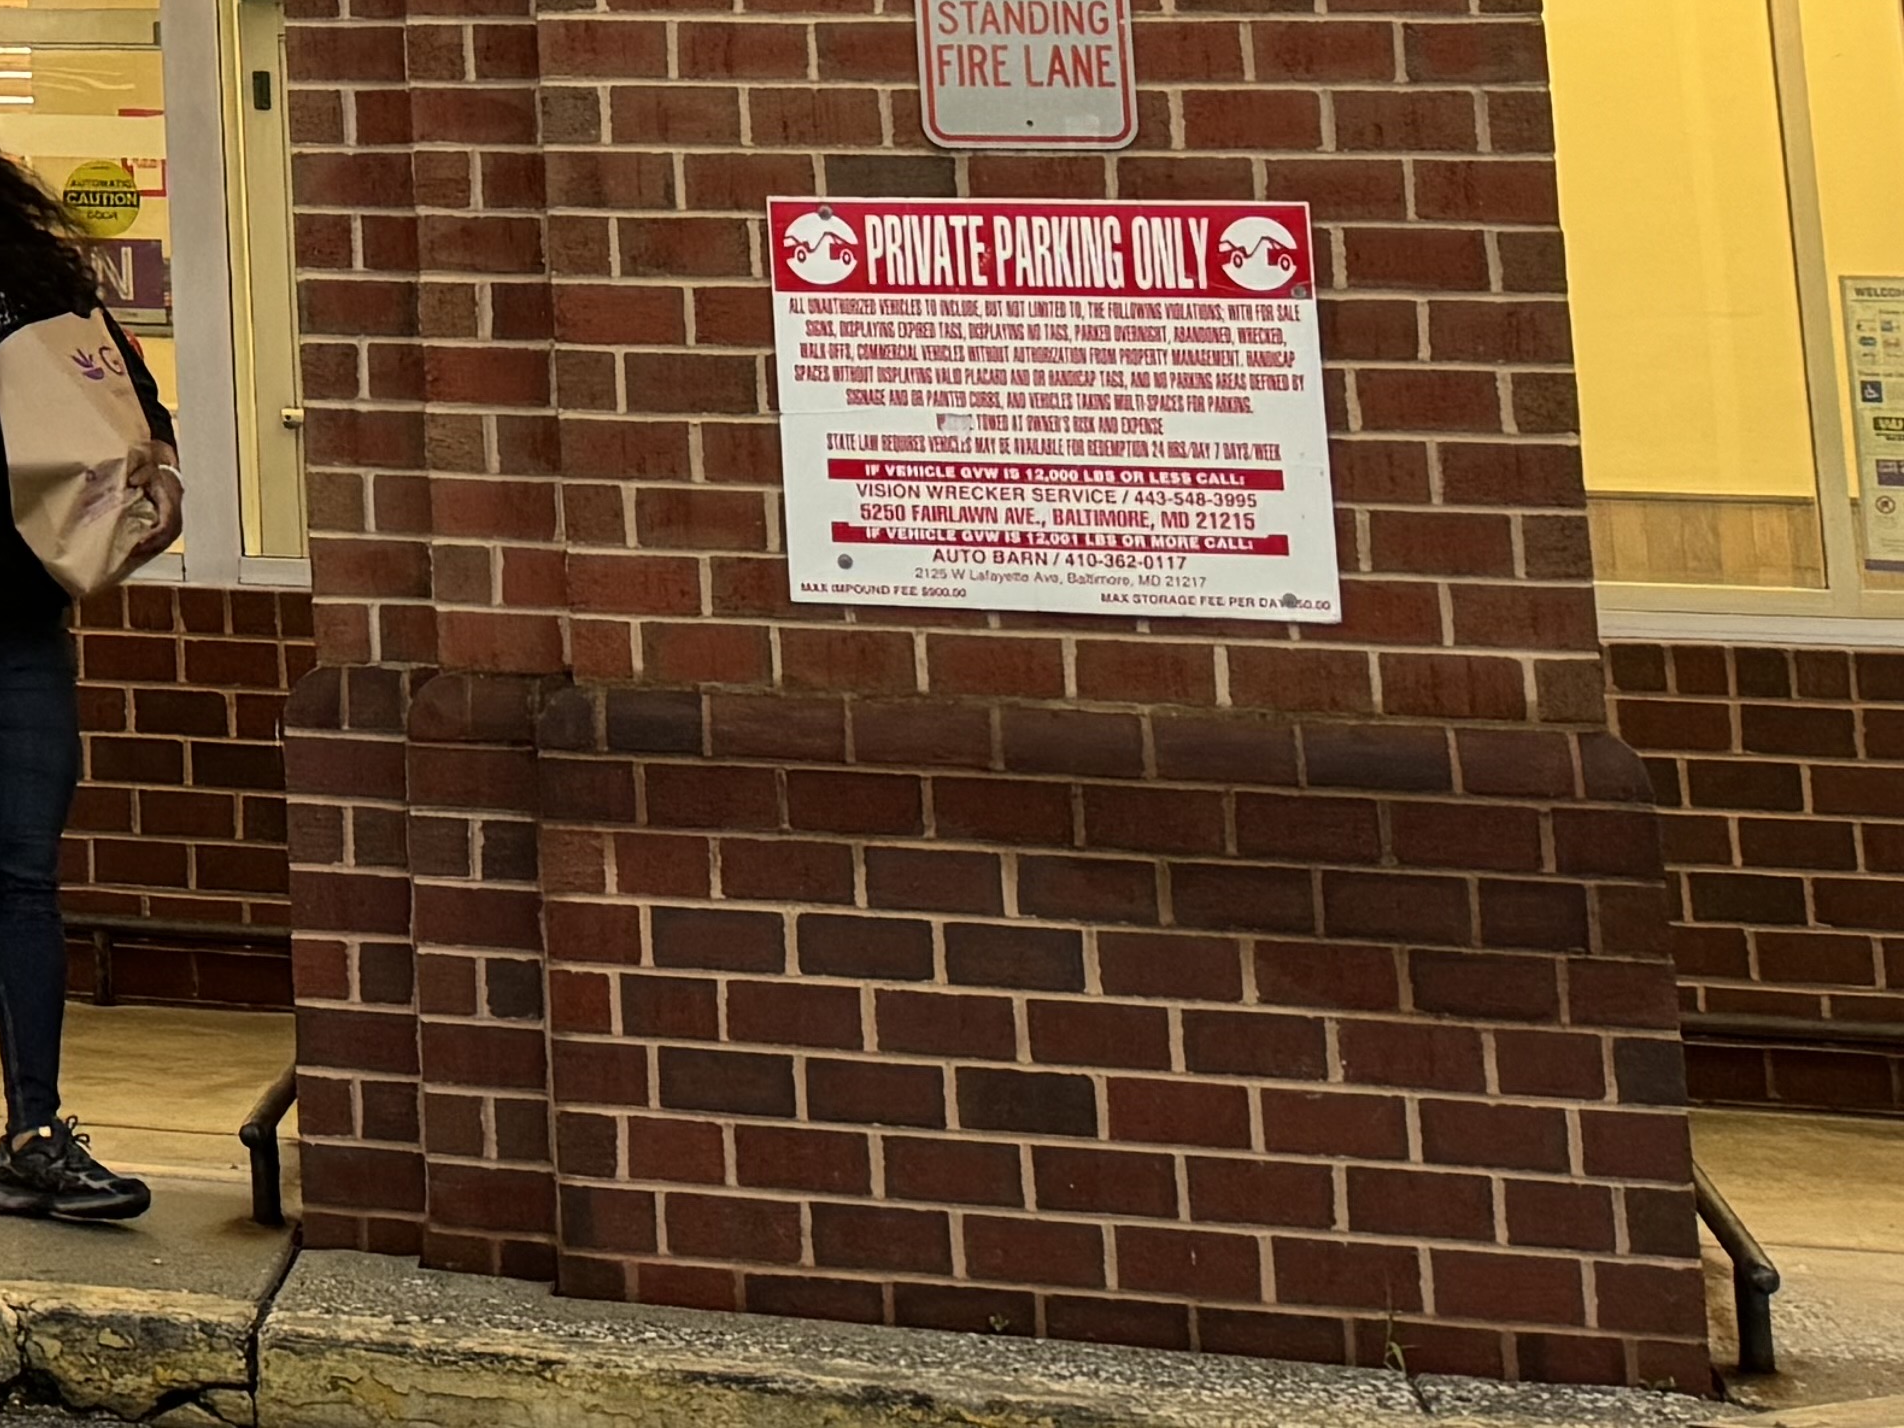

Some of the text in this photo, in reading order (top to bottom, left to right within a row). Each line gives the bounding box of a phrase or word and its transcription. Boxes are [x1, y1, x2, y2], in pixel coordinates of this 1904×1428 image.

[938, 0, 1109, 36] STANDING
[937, 44, 1116, 88] FIRE LANE
[66, 192, 137, 206] CAUTION
[864, 214, 1209, 290] PRIVATE PARKING ONLY
[1855, 287, 1904, 297] WELCO
[827, 434, 855, 452] STATE
[1153, 440, 1165, 458] 24
[865, 464, 880, 477] IF
[885, 465, 955, 479] VEHICLE
[1004, 468, 1020, 480] IS
[1026, 469, 1079, 482] 12,000
[1084, 470, 1115, 483] LBS
[1120, 471, 1145, 483] OR
[1149, 472, 1192, 485] LESS
[856, 483, 920, 499] VISION
[927, 485, 1025, 502] WRECKER
[1032, 487, 1117, 504] SERVICE
[1135, 490, 1257, 508] 443-548-3995
[860, 503, 1256, 531] 5250 FAIRLAWN AVE., BALTIMORE, MD 21215
[866, 528, 879, 540] IF
[889, 529, 956, 542] VEHICLE
[1005, 532, 1020, 544] IS
[1085, 534, 1117, 547] LBS
[1122, 535, 1145, 547] OR
[1151, 536, 1199, 549] MORE
[933, 548, 986, 564] AUTO
[993, 550, 1047, 566] BARN
[1065, 552, 1186, 570] 410-362-0117
[915, 567, 947, 579] 2125
[952, 569, 966, 580] W
[970, 569, 1030, 585] Lafayette
[1139, 575, 1160, 587] MD
[1166, 576, 1206, 588] 21217
[832, 583, 890, 596] IMPOUND
[894, 585, 918, 597] FEE
[1101, 593, 1129, 603] MAX
[1133, 594, 1196, 605] STORAGE
[1201, 596, 1224, 606] FEE
[1230, 597, 1255, 608] PER
[1286, 599, 1330, 611] 50.00
